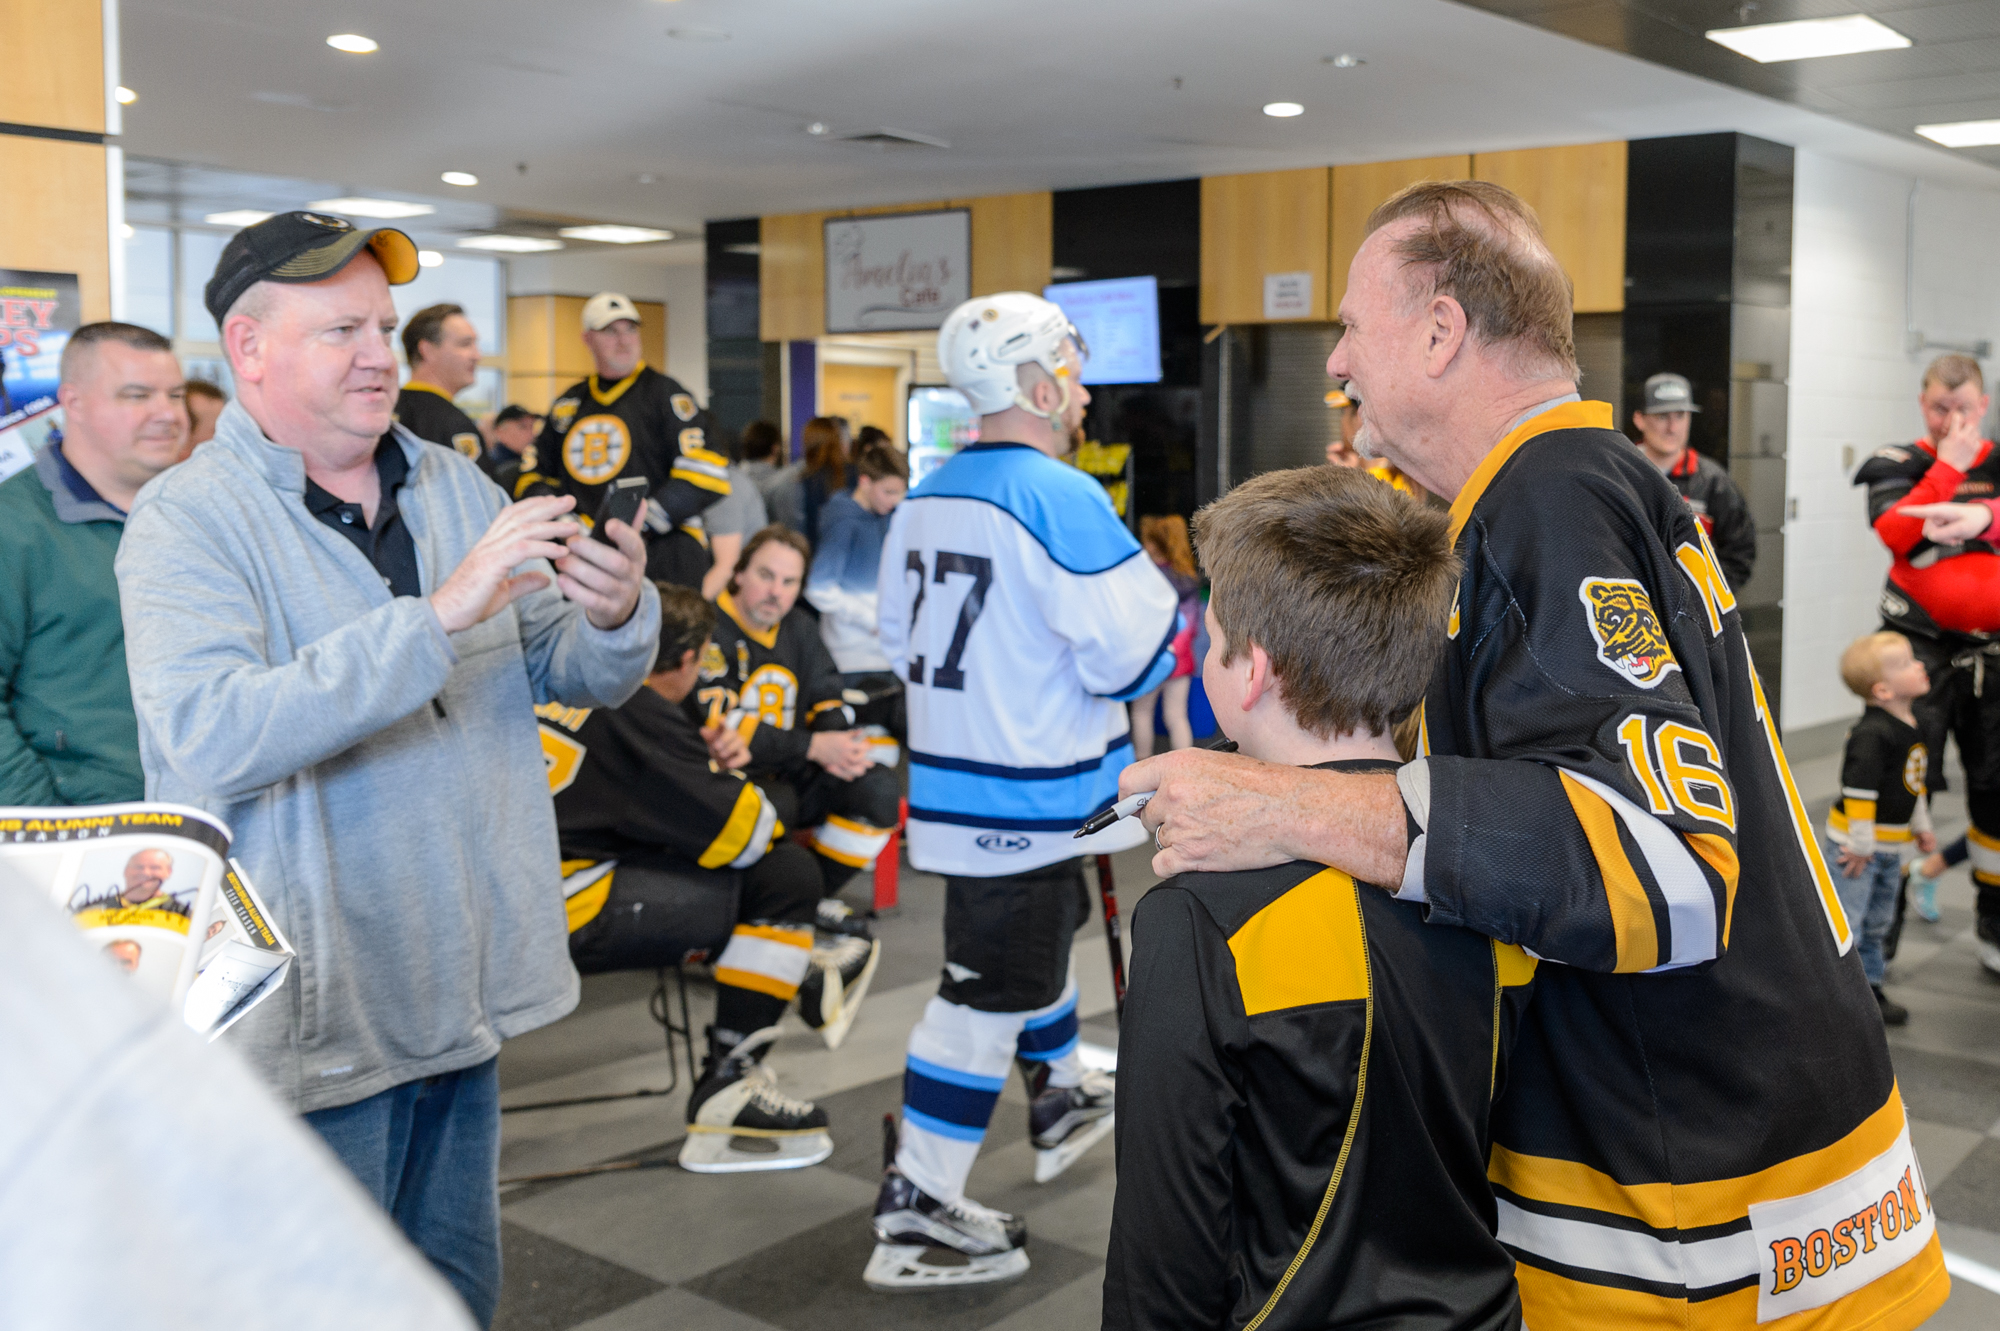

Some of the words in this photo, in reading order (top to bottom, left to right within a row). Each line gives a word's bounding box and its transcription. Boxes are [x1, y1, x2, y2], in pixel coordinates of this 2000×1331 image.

[25, 816, 115, 832] ALUMNI
[119, 813, 184, 827] TEAM
[1617, 713, 1737, 835] 16
[1769, 1165, 1922, 1296] BOSTON
